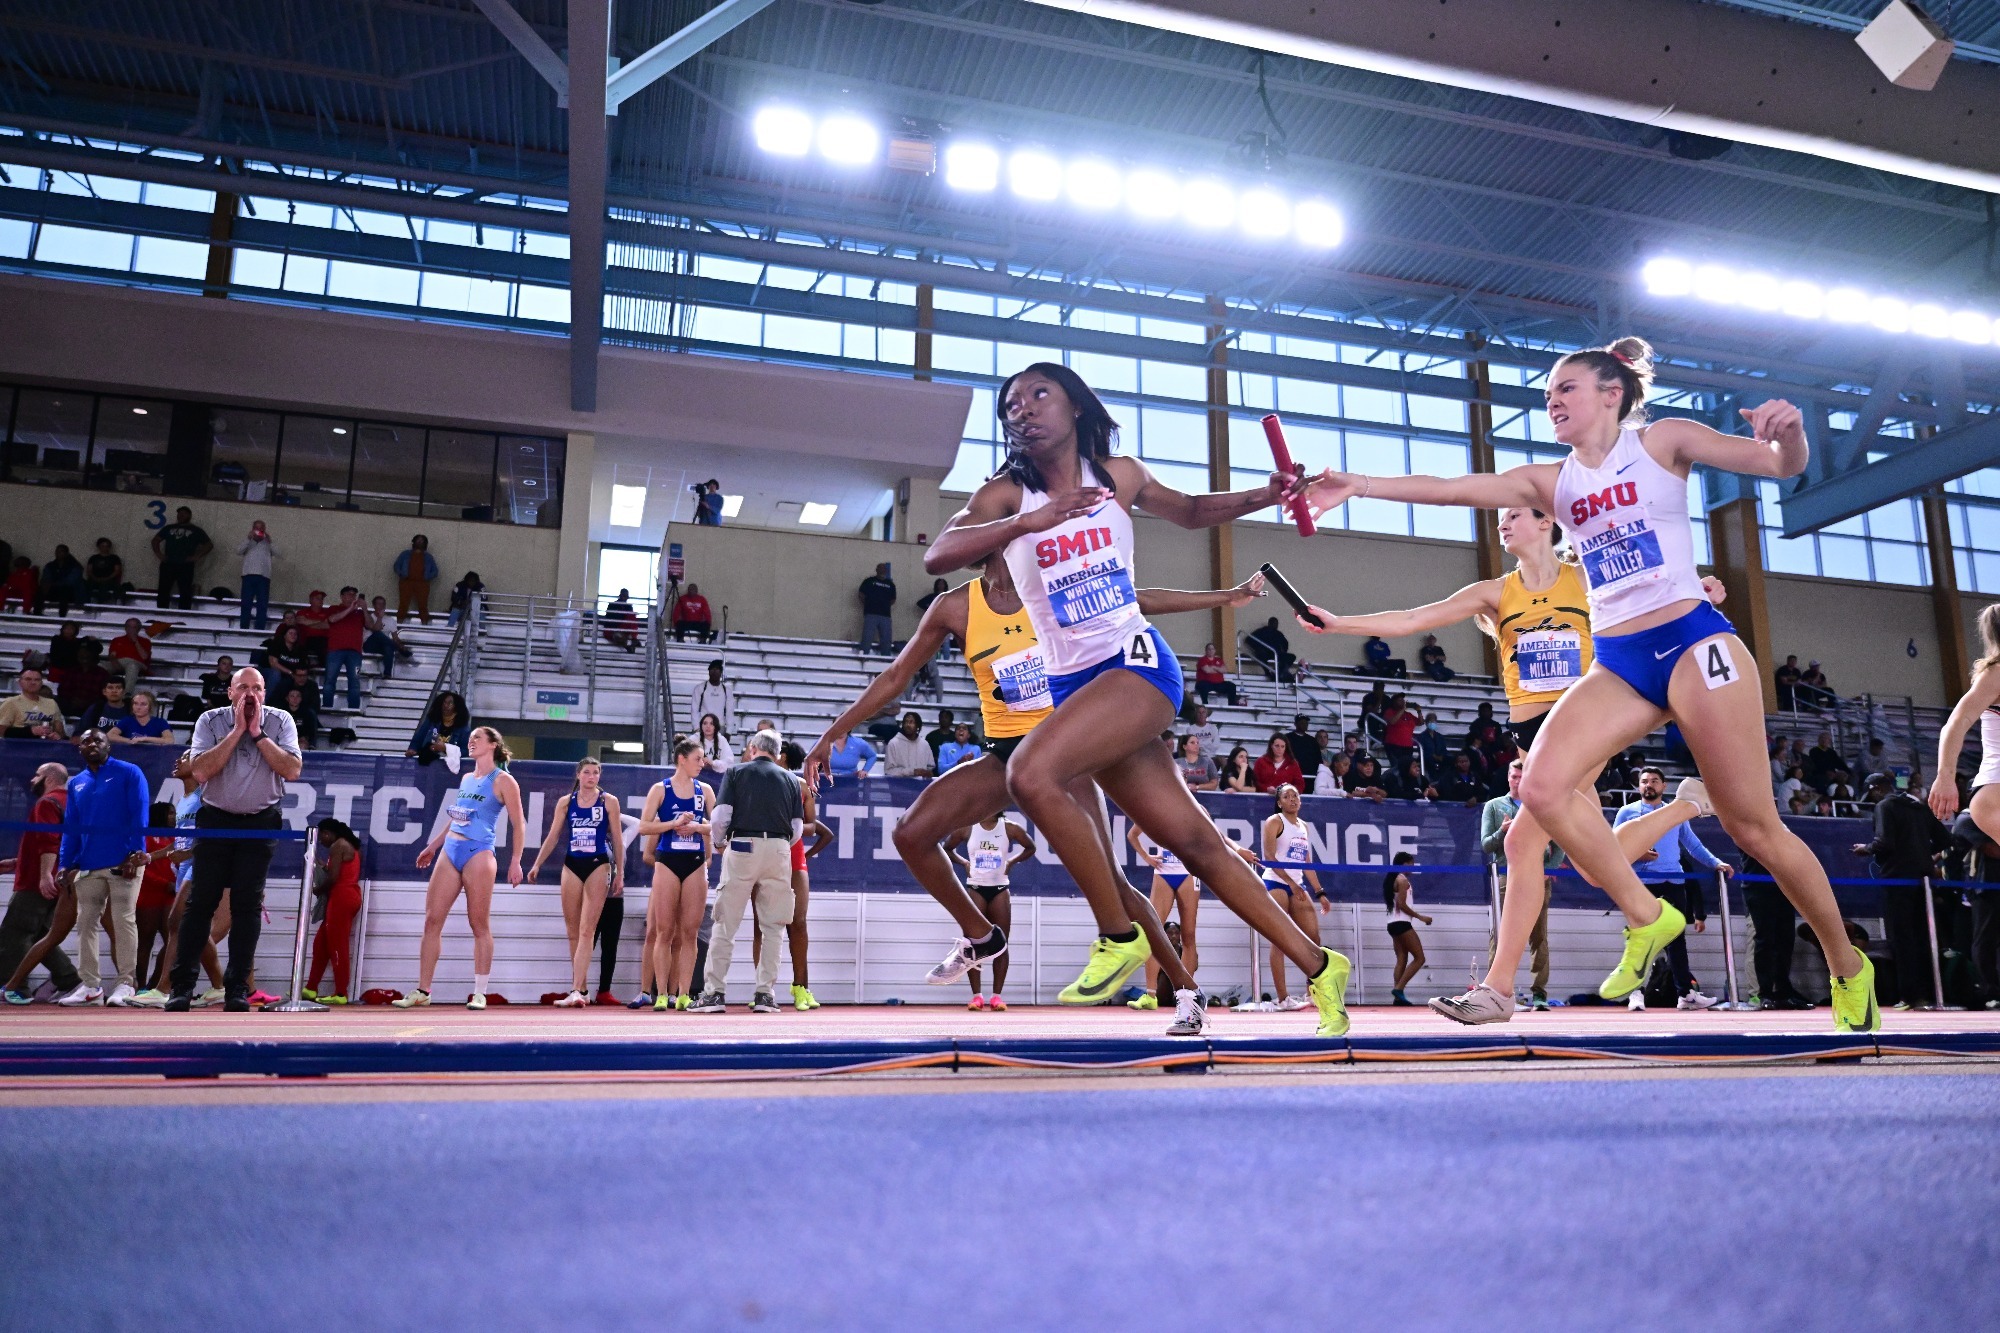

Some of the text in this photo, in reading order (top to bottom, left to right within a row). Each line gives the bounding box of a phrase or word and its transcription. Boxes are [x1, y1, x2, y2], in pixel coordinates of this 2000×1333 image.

[144, 500, 167, 530] 3
[1571, 481, 1639, 526] SMU
[1036, 527, 1113, 569] SMU
[1580, 519, 1647, 553] AMERICAN
[1602, 541, 1630, 559] EMILY
[1048, 557, 1120, 593] AMERICAN
[1599, 549, 1645, 582] WALLER
[1064, 575, 1111, 600] WHITNEY
[1064, 585, 1124, 623] WILLIAMS
[1131, 634, 1152, 664] 4
[1520, 640, 1576, 652] AMERICAN
[1536, 651, 1560, 661] SADIE
[1907, 638, 1918, 658] 6
[998, 656, 1043, 678] AMERIC
[1529, 660, 1569, 678] MILLARD
[1708, 643, 1730, 682] 4
[150, 777, 545, 848] ARICAN
[595, 807, 601, 820] 3
[697, 795, 703, 810] 3
[571, 817, 601, 828] Tulsa
